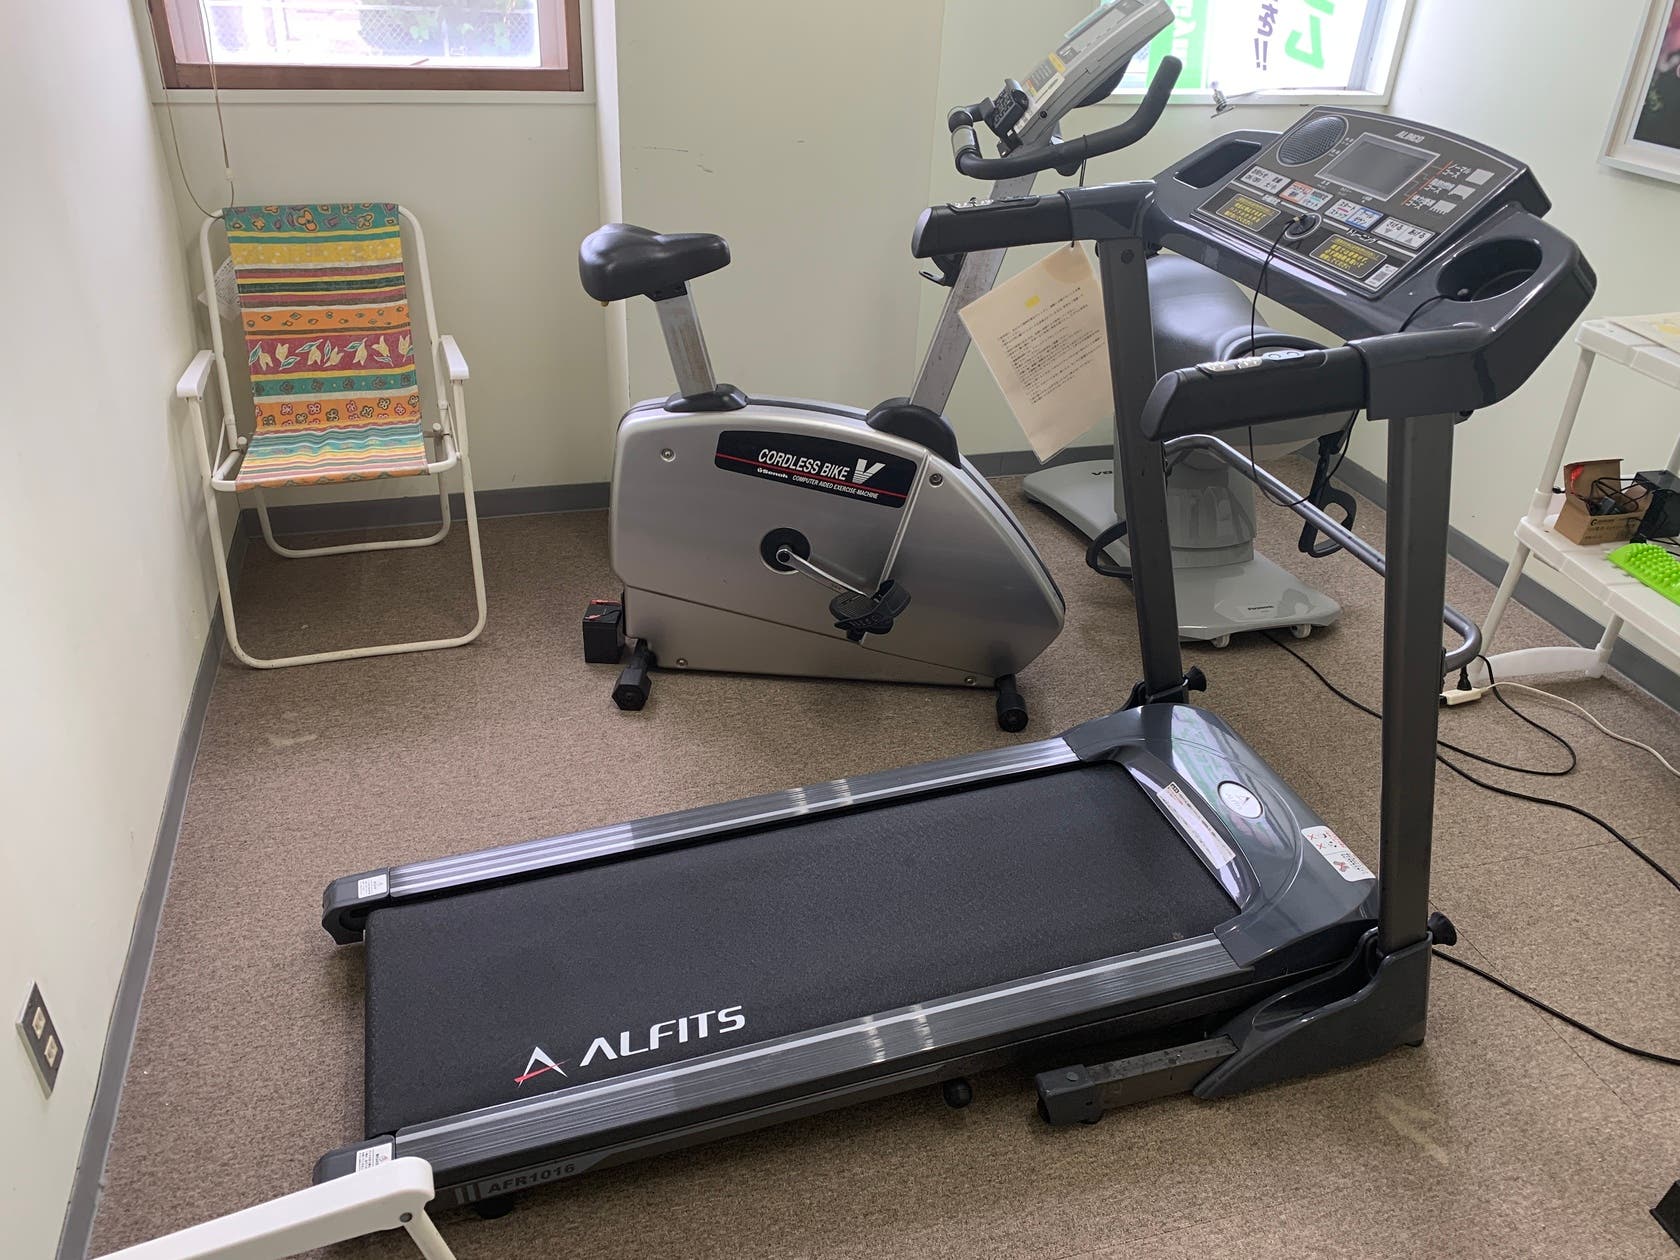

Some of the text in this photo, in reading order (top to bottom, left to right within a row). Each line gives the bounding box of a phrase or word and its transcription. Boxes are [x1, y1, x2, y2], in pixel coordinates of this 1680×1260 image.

[758, 448, 820, 474] CORDLESS
[822, 462, 850, 481] BIKE
[792, 474, 819, 486] COMPUTER
[819, 481, 834, 489] AIDED
[579, 1005, 746, 1067] ALFITS
[487, 1163, 575, 1194] AFR1016
